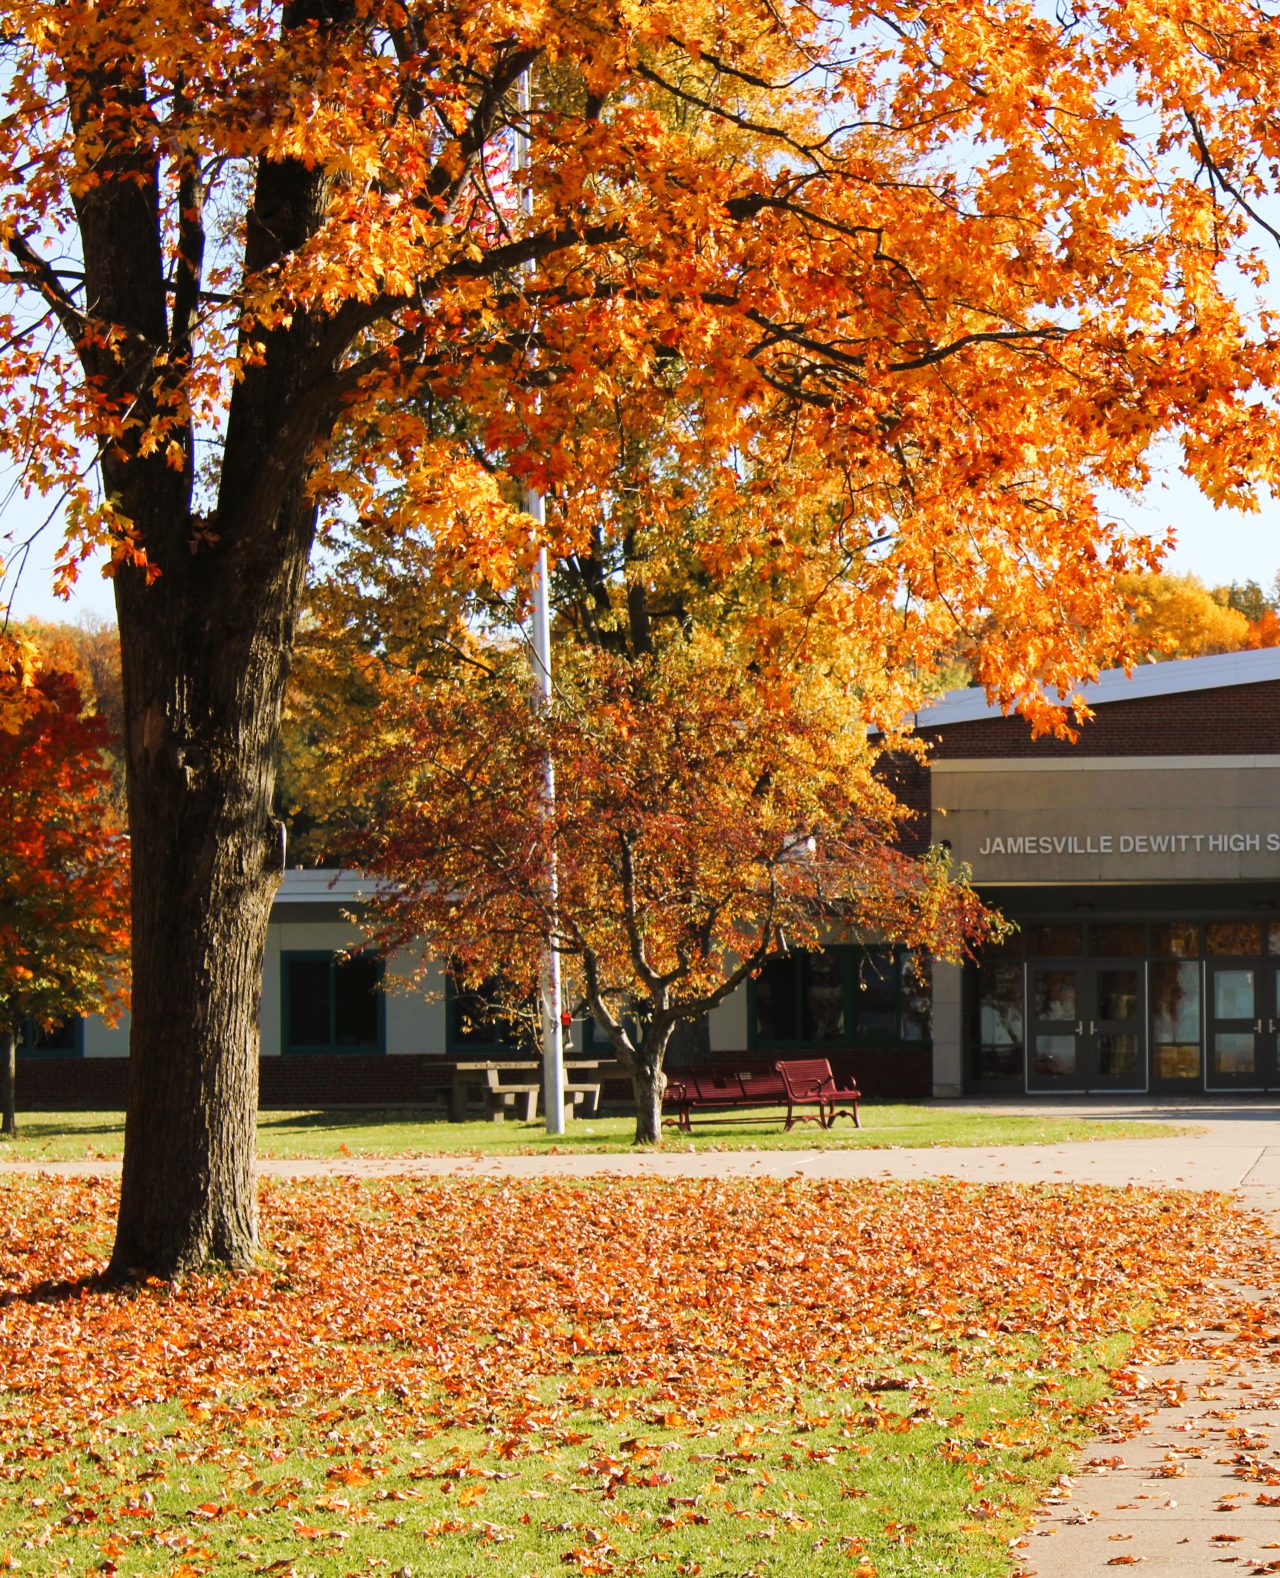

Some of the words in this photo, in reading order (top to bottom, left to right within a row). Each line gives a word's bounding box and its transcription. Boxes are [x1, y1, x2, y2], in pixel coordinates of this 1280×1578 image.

[979, 836, 1113, 855] JAMESVILLE
[1119, 835, 1205, 853] DEWITT
[1208, 834, 1260, 852] HIGH
